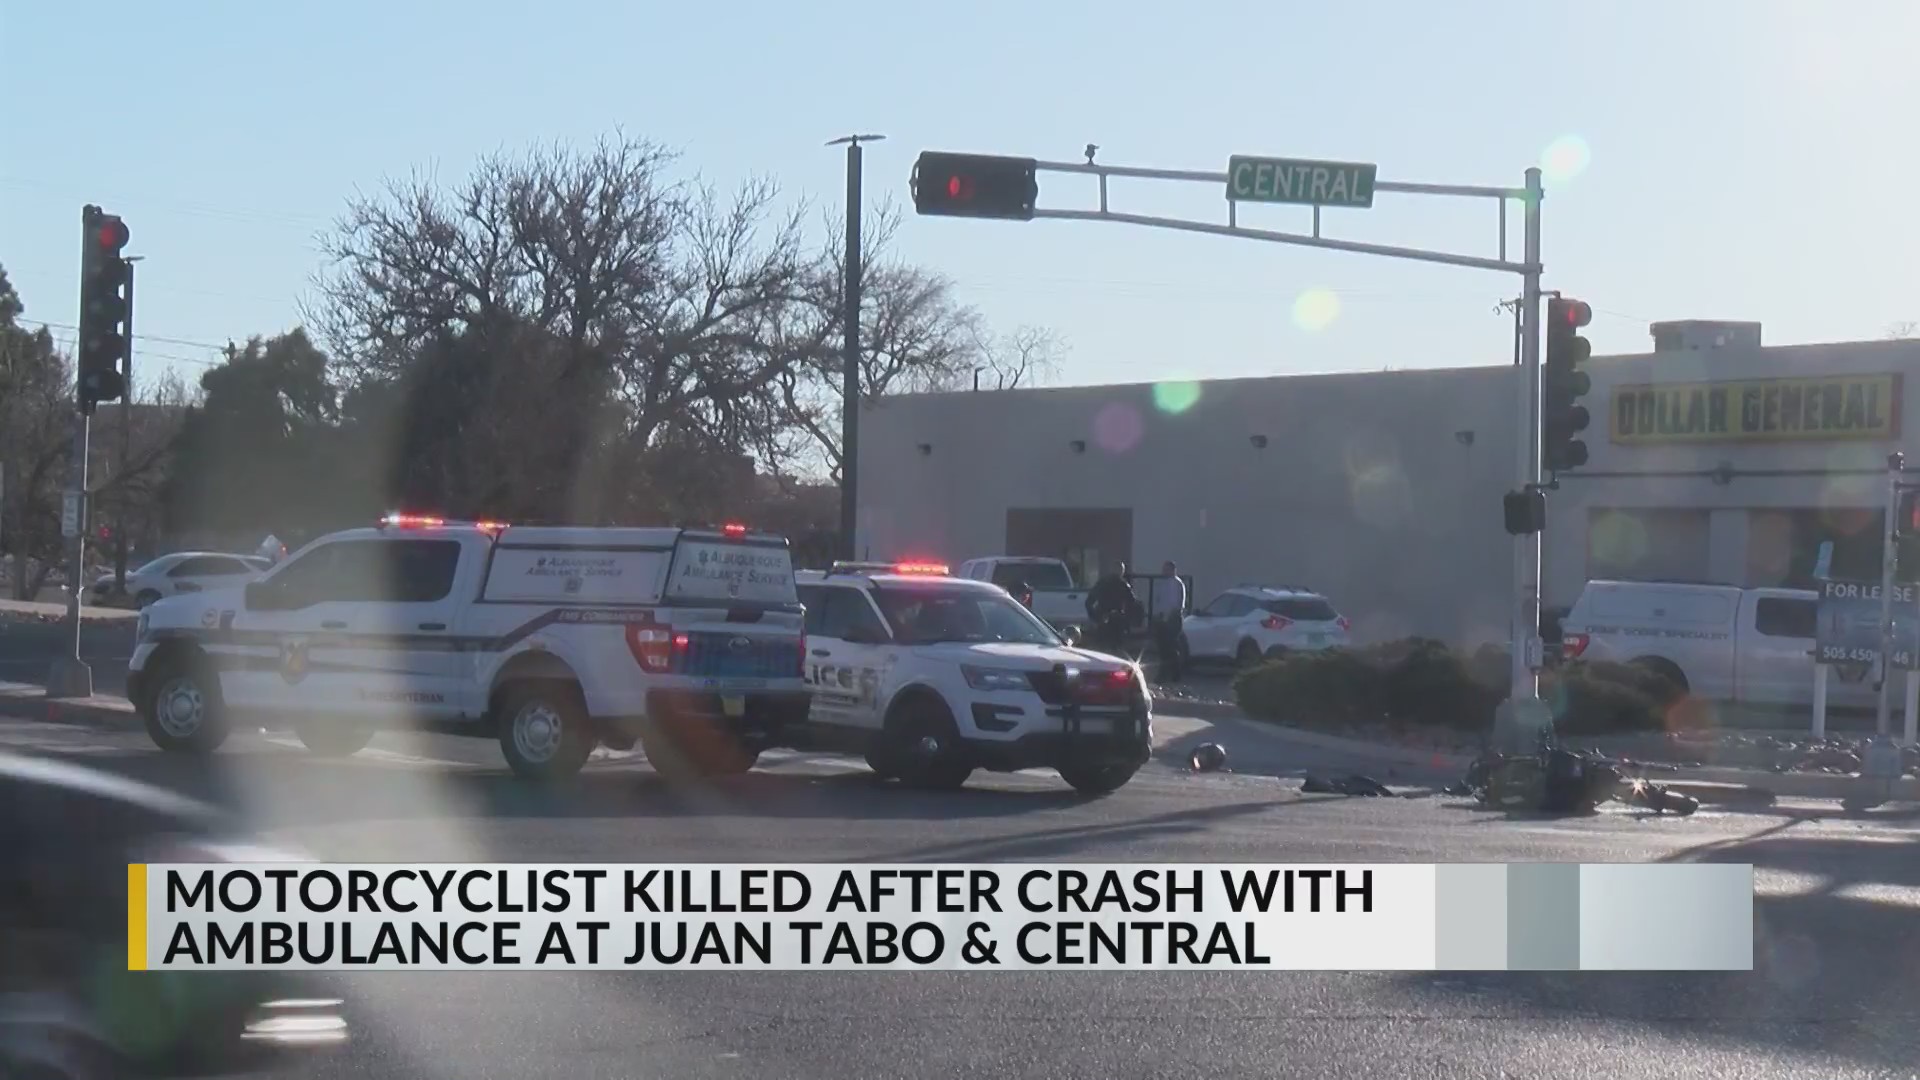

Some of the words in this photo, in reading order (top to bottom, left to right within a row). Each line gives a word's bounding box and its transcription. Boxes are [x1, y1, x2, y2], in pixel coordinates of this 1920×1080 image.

[1233, 162, 1368, 201] CENTRAL
[1618, 387, 1729, 435] DOLLAR
[1741, 382, 1884, 432] GENERAL
[710, 550, 783, 568] ALBUQUERQUE
[683, 564, 743, 582] AMBULANCE
[749, 569, 788, 585] SERVICE
[1825, 583, 1858, 598] FOR
[1861, 585, 1913, 602] LESE
